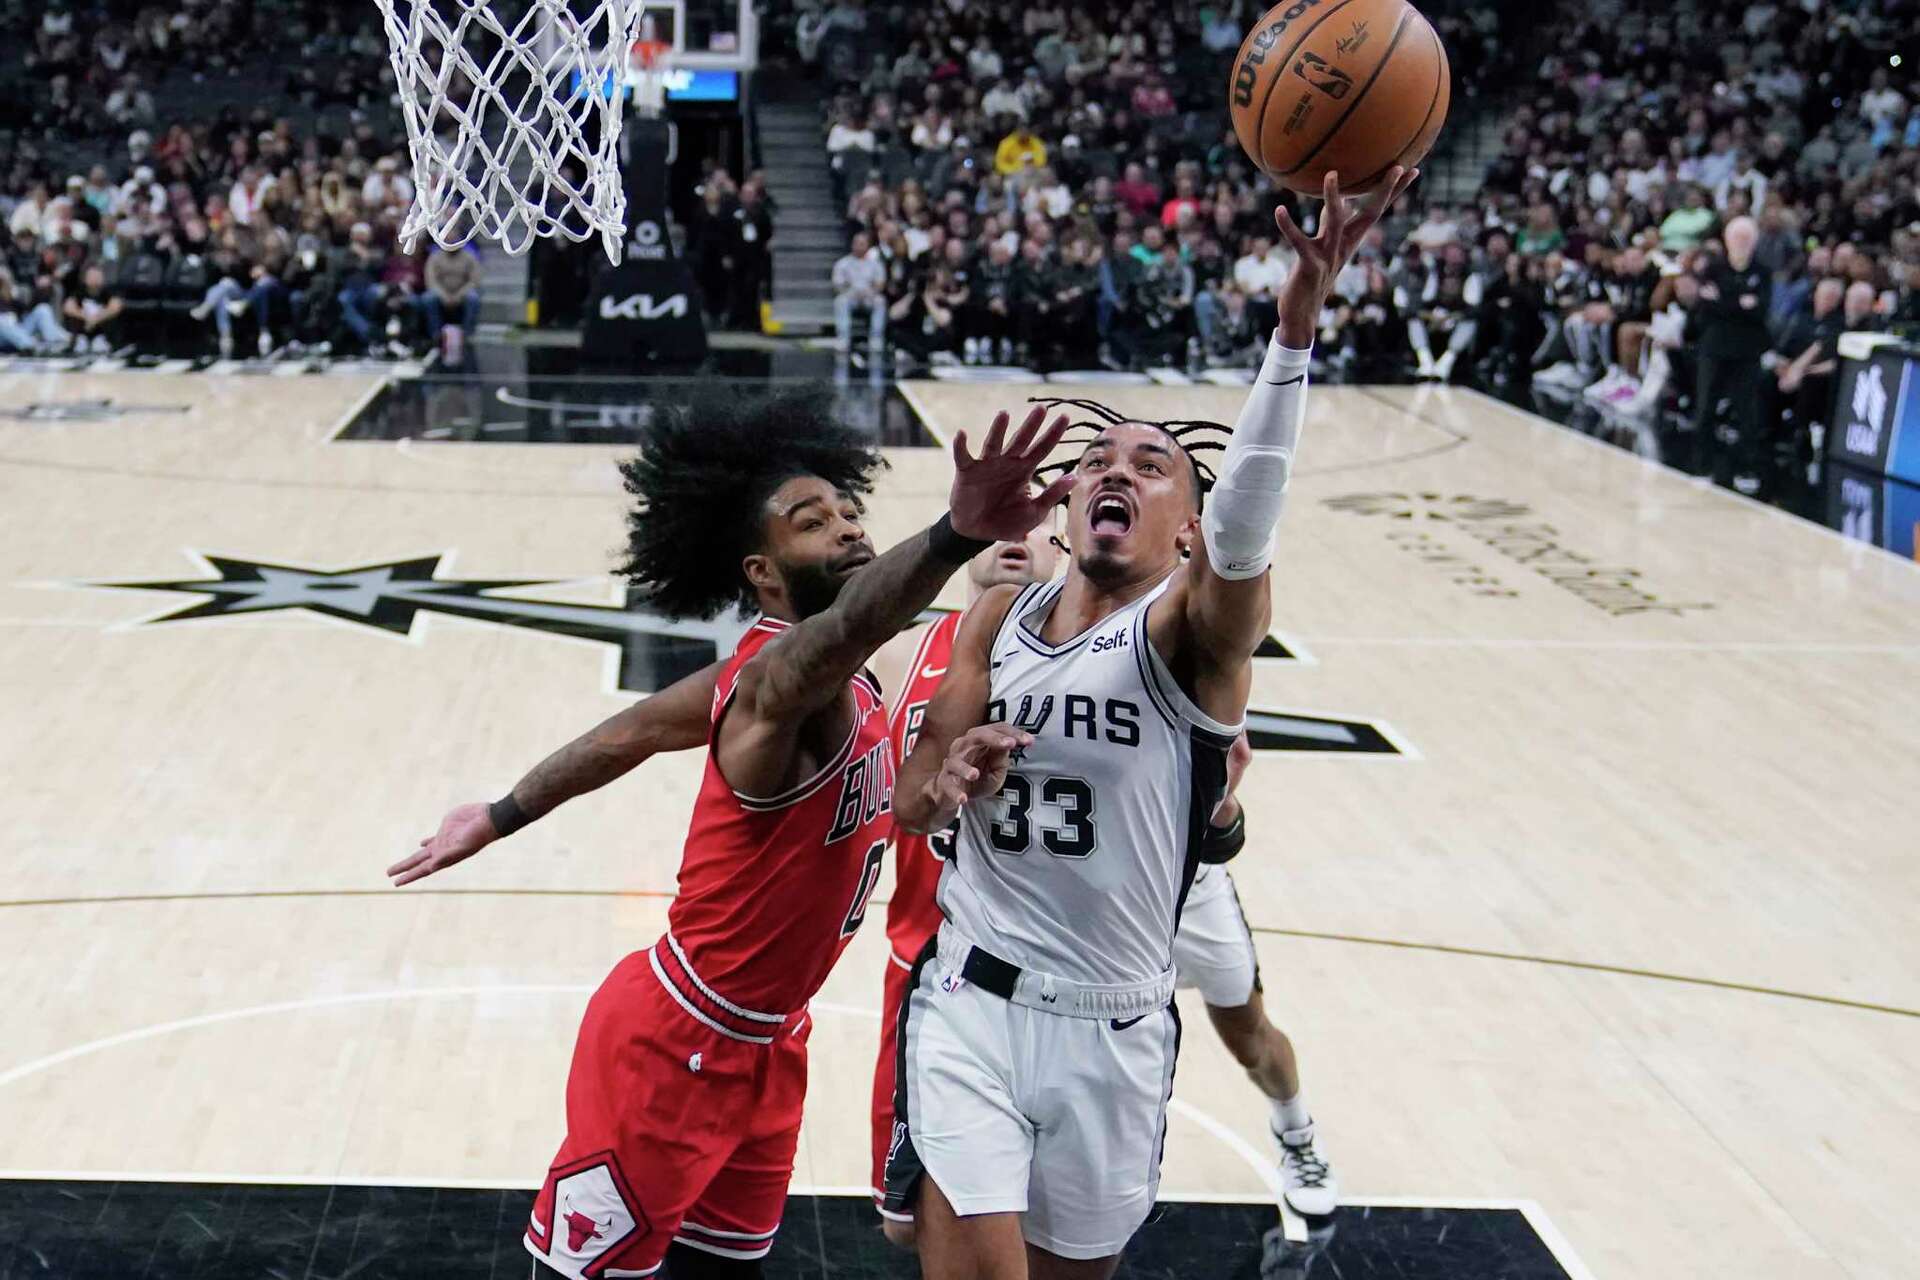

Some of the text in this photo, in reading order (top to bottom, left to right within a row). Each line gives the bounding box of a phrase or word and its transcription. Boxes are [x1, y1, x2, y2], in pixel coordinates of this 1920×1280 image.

[600, 293, 688, 319] KIA
[1091, 627, 1128, 653] Self.
[989, 772, 1098, 859] 33
